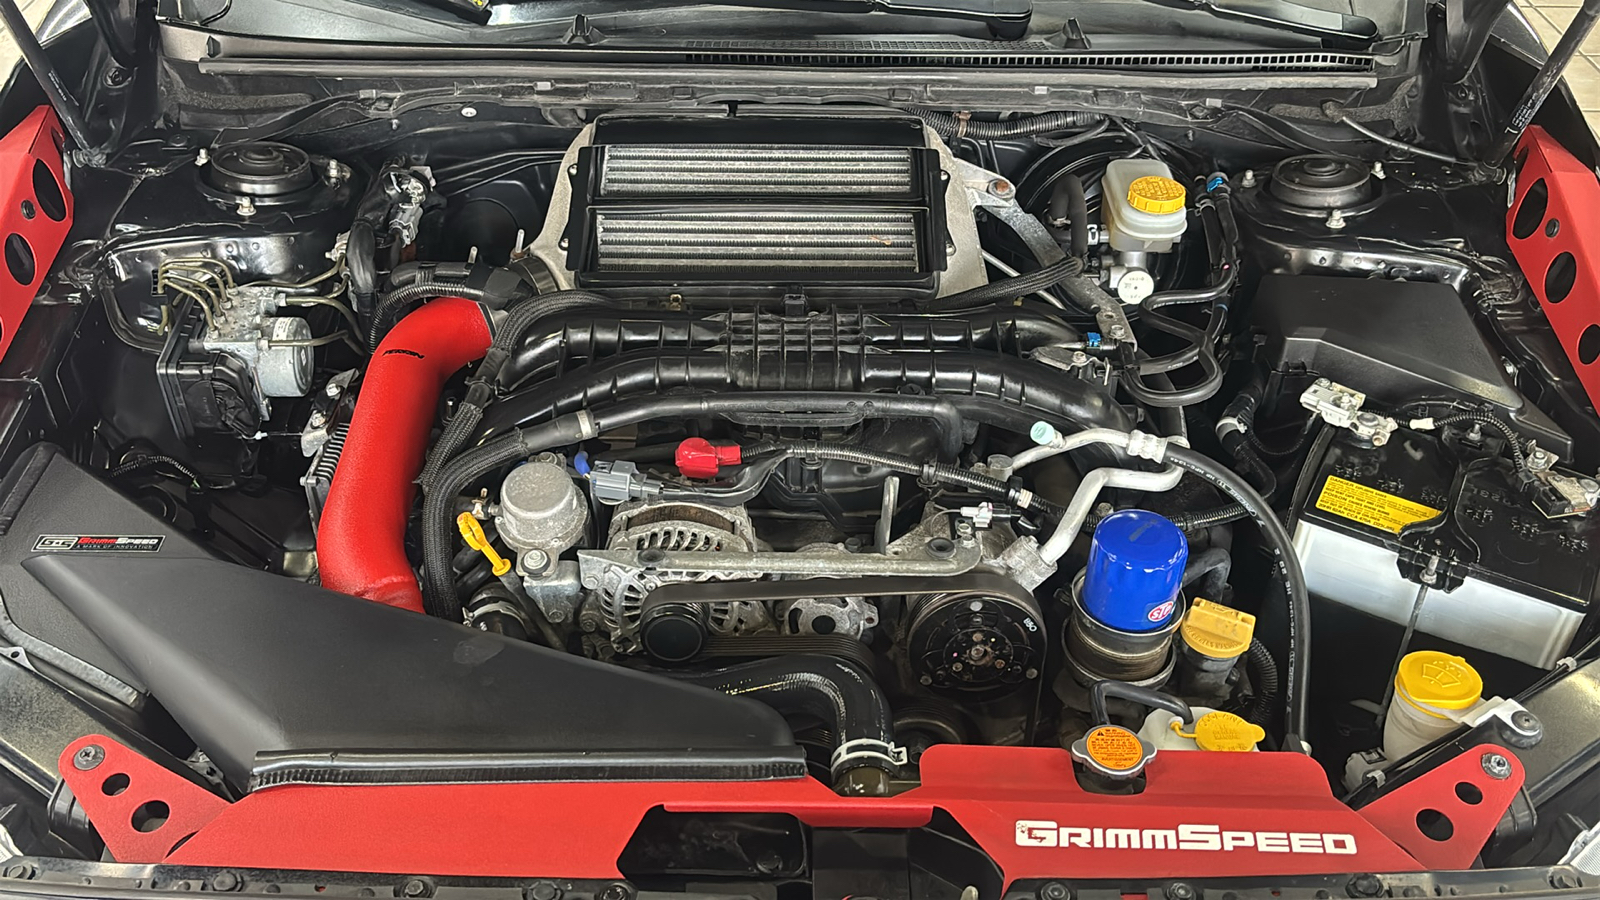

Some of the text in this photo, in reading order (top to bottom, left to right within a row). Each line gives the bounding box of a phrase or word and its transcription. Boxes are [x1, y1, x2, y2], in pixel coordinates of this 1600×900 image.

[1330, 477, 1354, 487] DANGER
[1324, 491, 1347, 501] POISON
[1150, 602, 1173, 620] STP
[1014, 819, 1358, 855] GRIMMSPEED
